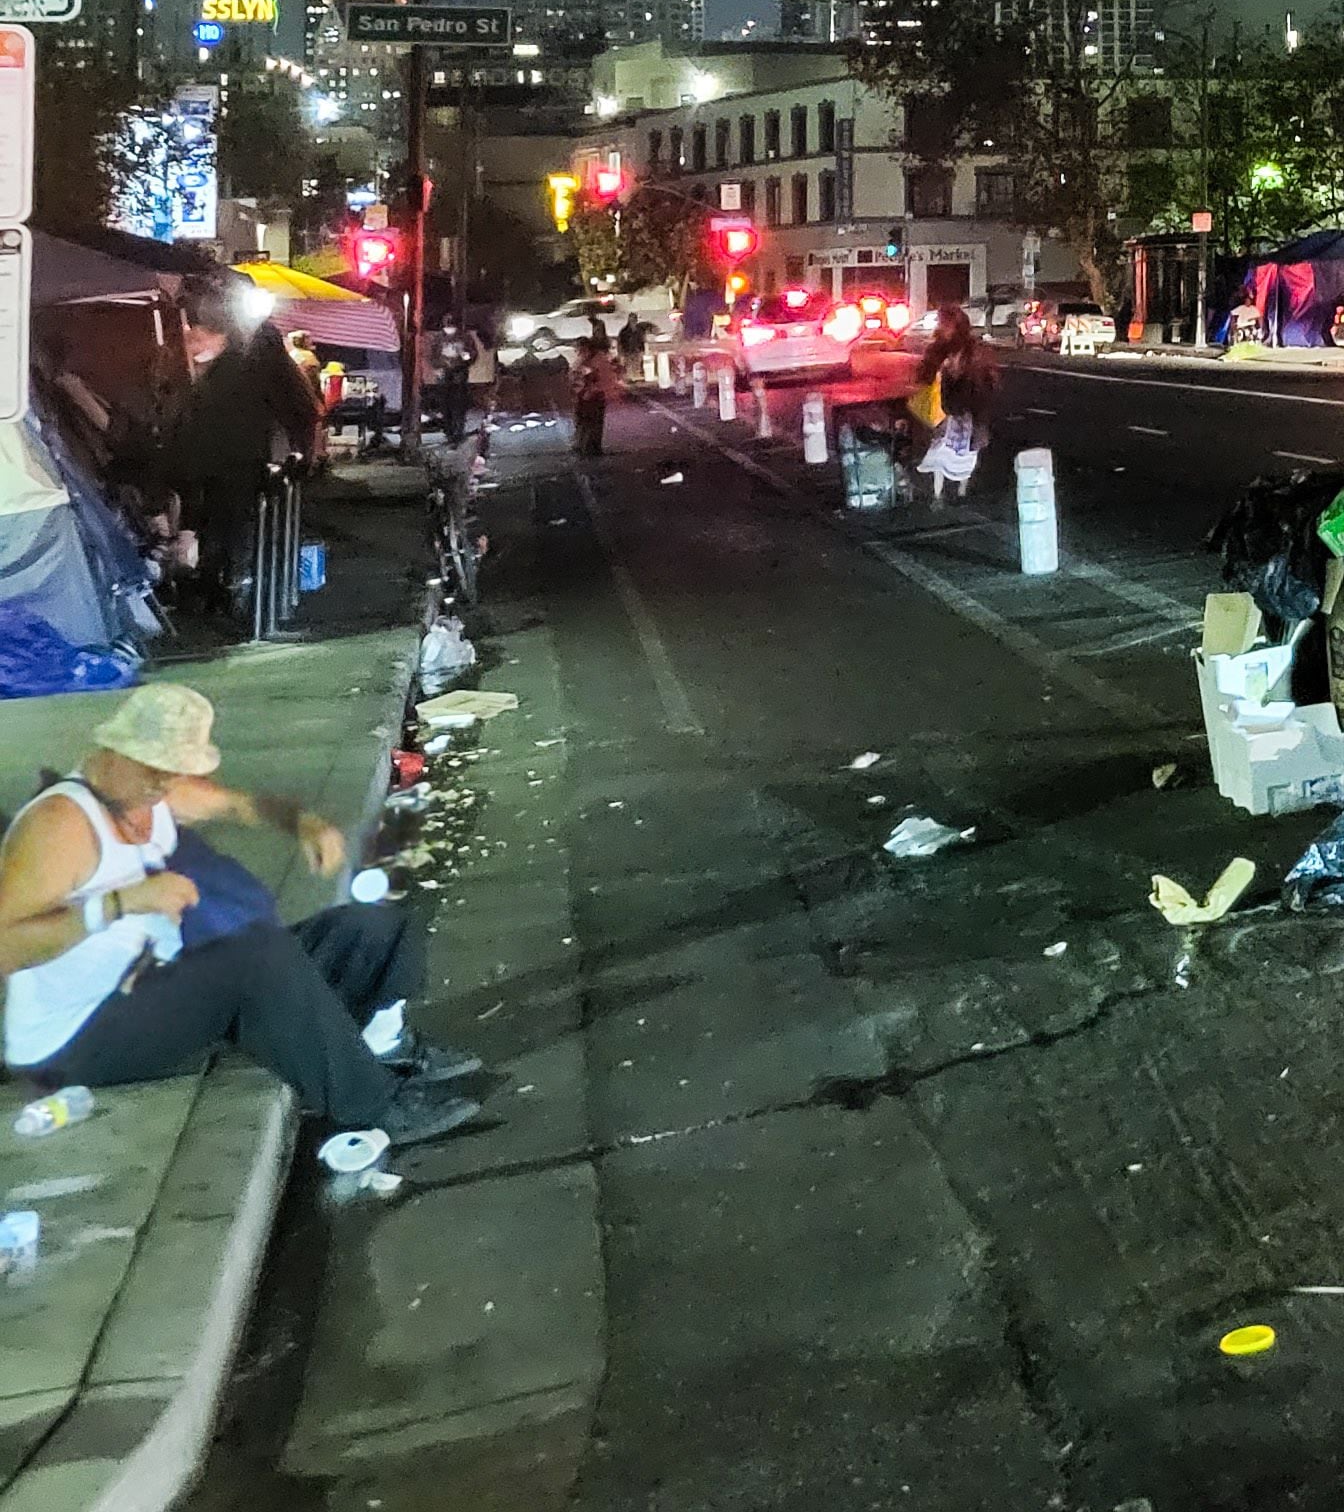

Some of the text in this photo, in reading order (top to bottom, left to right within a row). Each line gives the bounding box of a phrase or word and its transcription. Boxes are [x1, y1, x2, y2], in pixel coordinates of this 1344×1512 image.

[358, 15, 499, 33] San Pedro St
